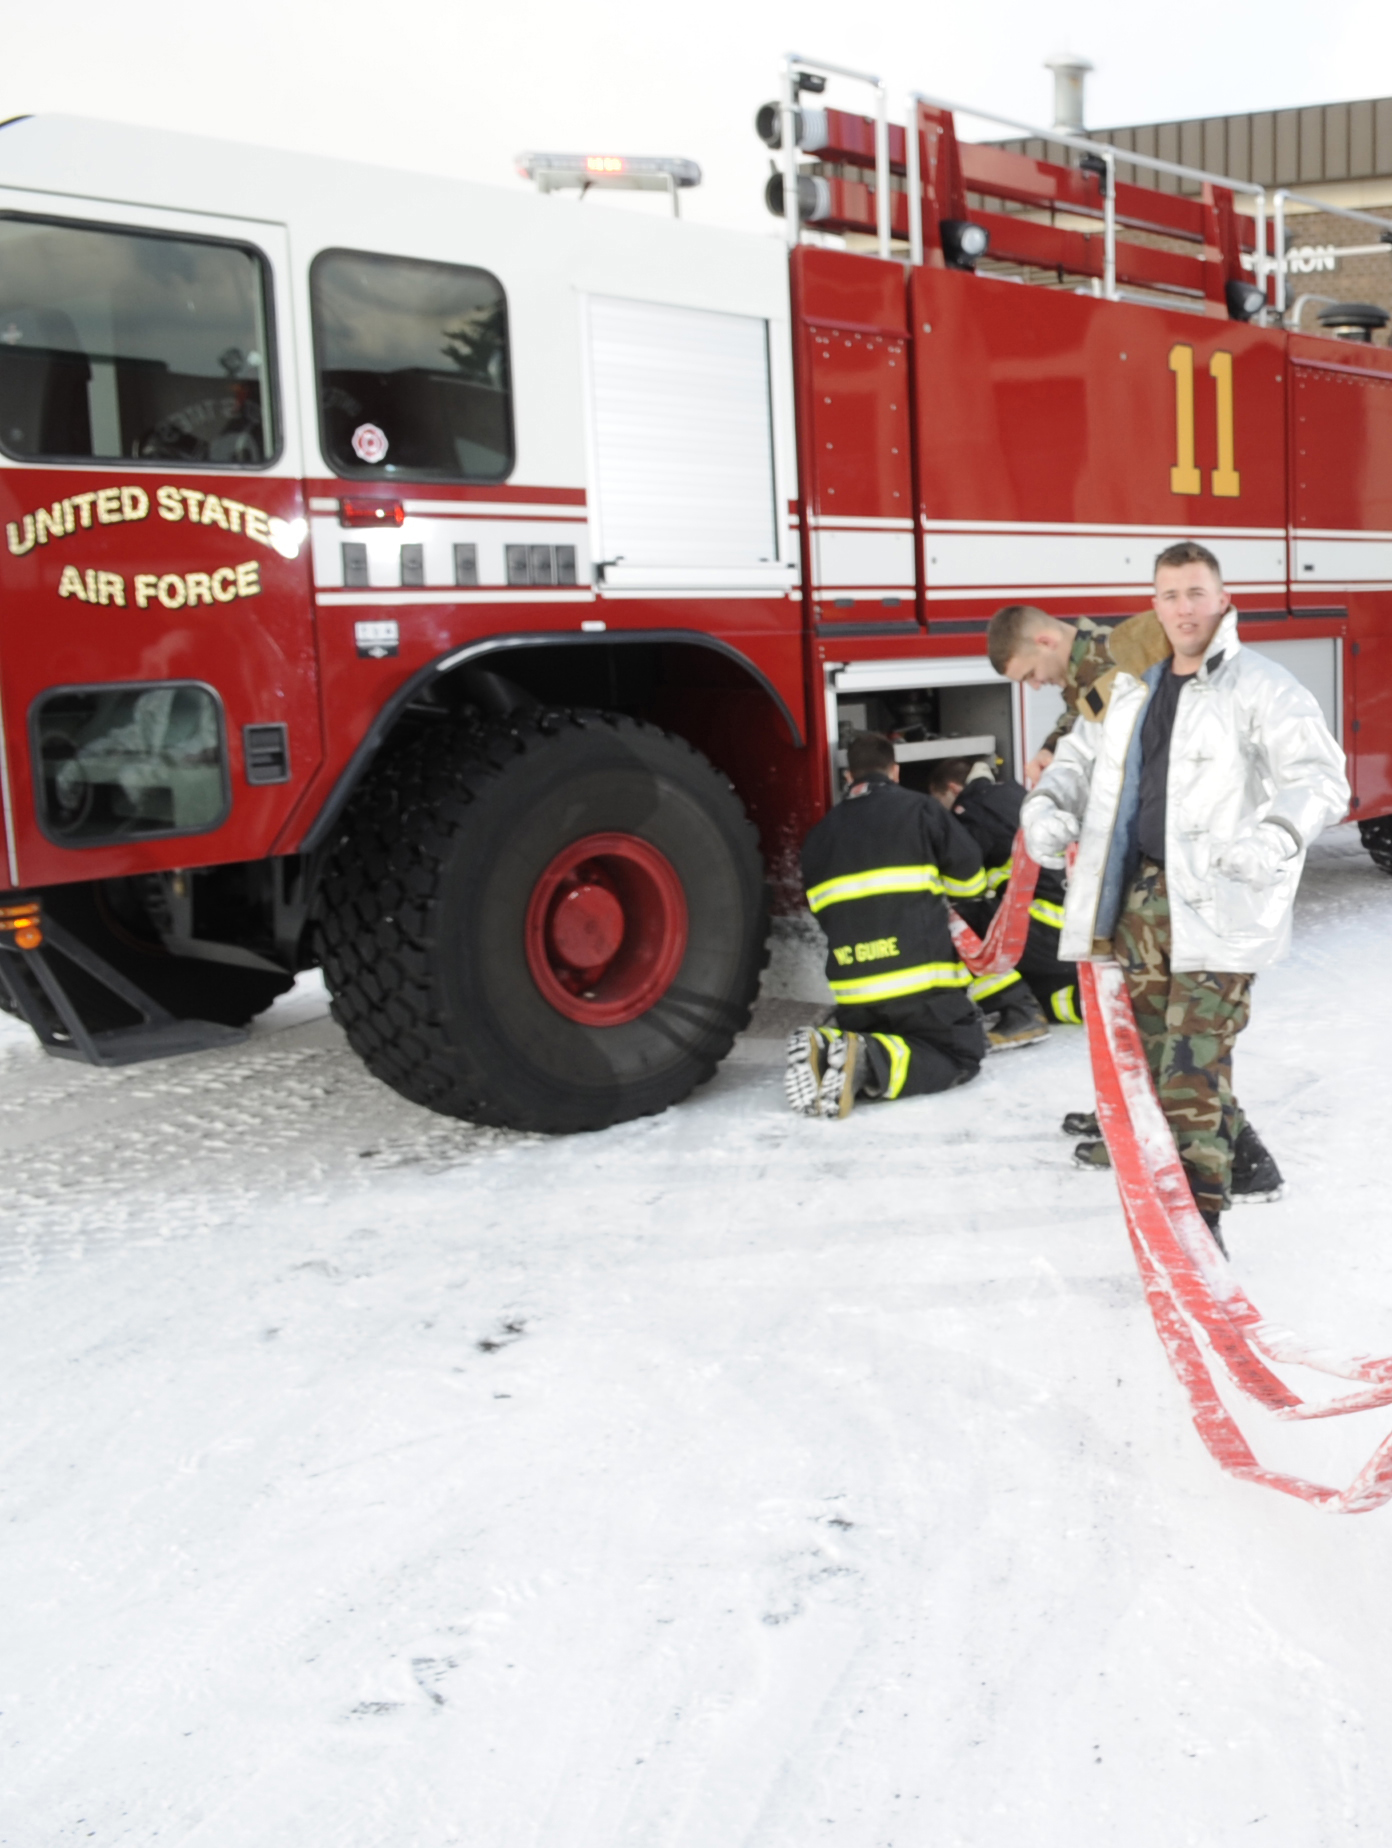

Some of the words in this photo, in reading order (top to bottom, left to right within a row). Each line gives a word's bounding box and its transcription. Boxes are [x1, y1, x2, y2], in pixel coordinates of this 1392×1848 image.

[1169, 343, 1240, 498] 11
[6, 485, 149, 555] UNITED
[156, 485, 303, 559] STATE
[58, 565, 126, 607] AIR
[134, 560, 260, 608] FORCE
[855, 936, 900, 963] GUIRE
